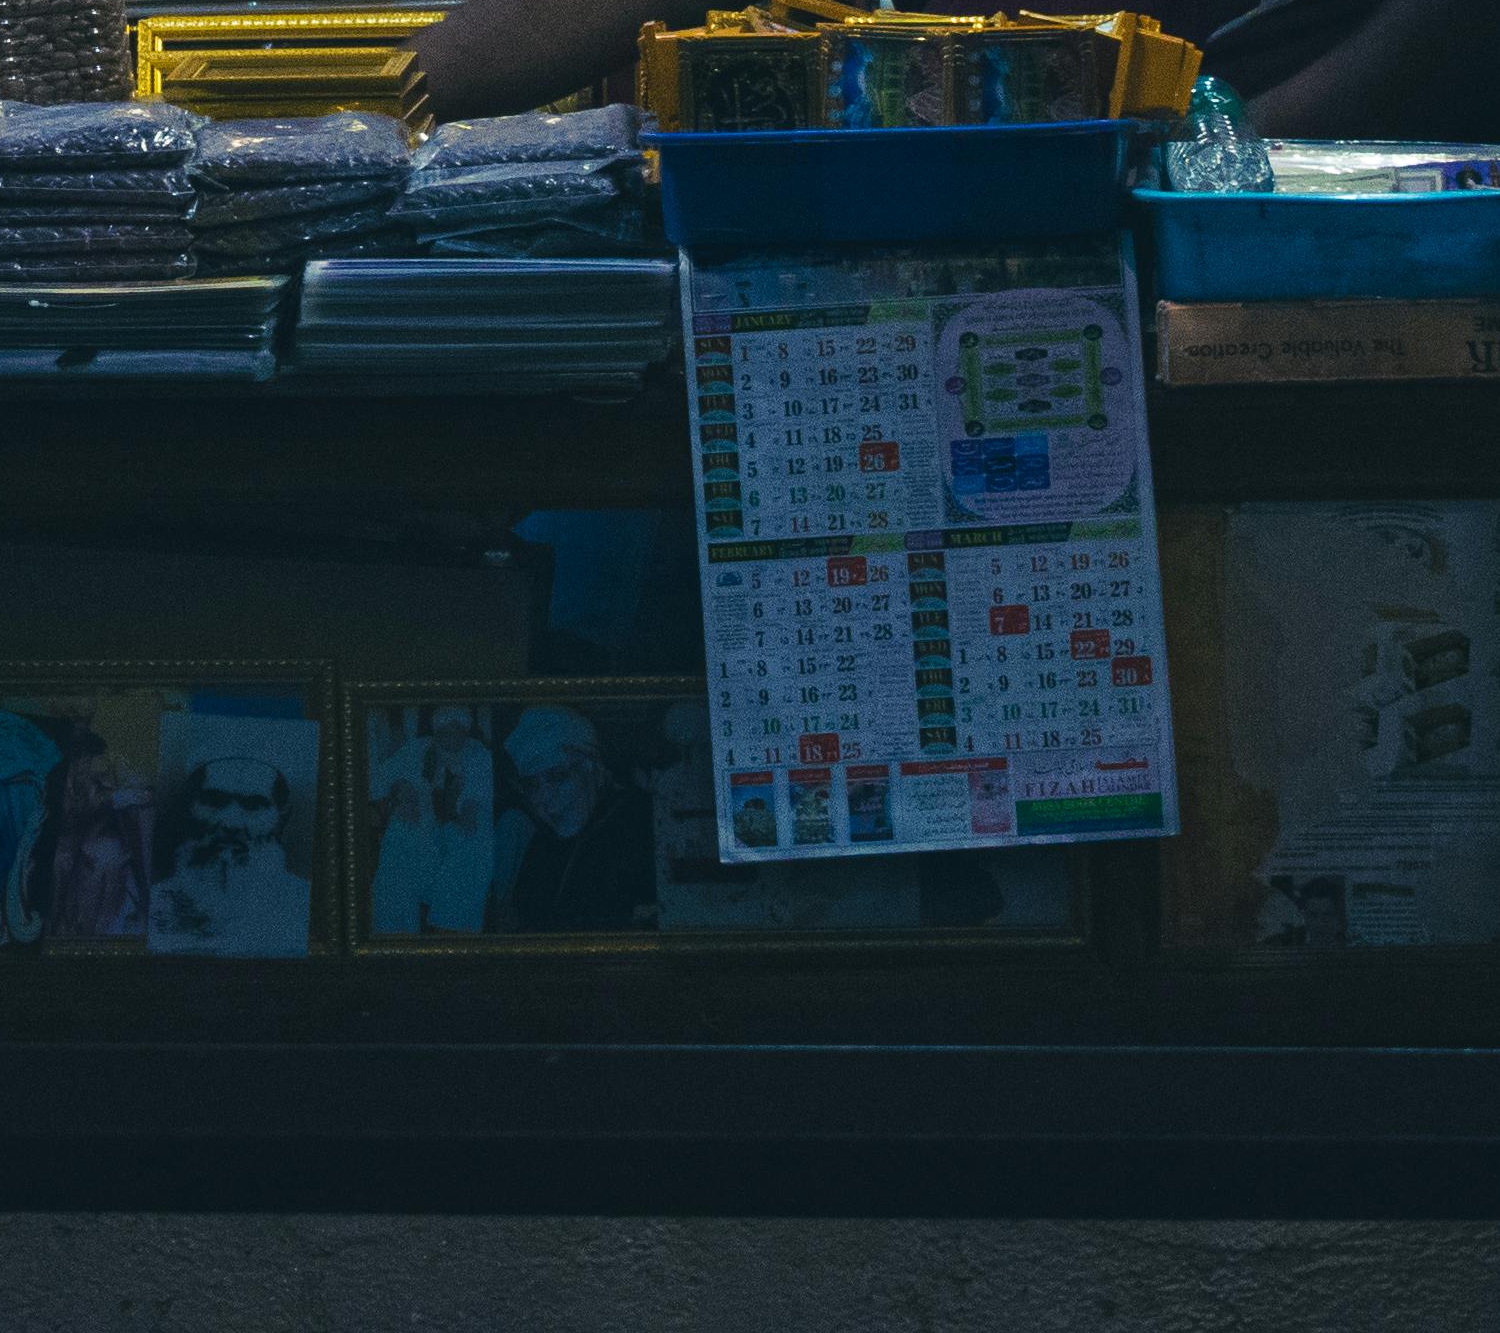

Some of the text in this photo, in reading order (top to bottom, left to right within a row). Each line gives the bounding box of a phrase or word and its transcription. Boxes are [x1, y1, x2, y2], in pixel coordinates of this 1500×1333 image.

[734, 316, 793, 329] JANUARY
[817, 341, 835, 357] 15
[856, 338, 876, 354] 22
[895, 336, 916, 352] 29
[1281, 339, 1366, 358] Valuable
[1378, 338, 1406, 356] The
[819, 369, 837, 385] 16
[858, 367, 878, 383] 23
[897, 365, 918, 381] 30
[784, 400, 803, 417] 10
[821, 398, 840, 414] 17
[860, 396, 880, 412] 24
[899, 394, 919, 410] 31
[785, 430, 803, 445] 11
[823, 427, 842, 443] 18
[861, 425, 883, 441] 25
[787, 458, 805, 475] 12
[825, 456, 843, 472] 19
[789, 488, 808, 504] 13
[825, 485, 846, 501] 20
[865, 483, 887, 500] 27
[791, 517, 809, 533] 14
[828, 514, 846, 530] 21
[868, 512, 889, 528] 28
[950, 531, 1003, 545] MARCH
[711, 545, 775, 560] FEBRUARY
[1030, 552, 1129, 572] 12 19 26
[792, 566, 889, 587] 12 19 26
[1032, 581, 1130, 601] 13 20 27
[794, 595, 890, 616] 13 20 27
[1034, 610, 1133, 630] 14 21 28
[796, 624, 892, 645] 14 21 28
[1036, 639, 1135, 660] 15 22 29
[798, 655, 856, 674] 15 22
[1038, 669, 1137, 689] 16 23 30
[800, 685, 857, 703] 16 23
[1002, 698, 1138, 720] 10 17 24 31
[763, 714, 859, 734] 10 17 24
[1004, 729, 1102, 749] 11 18 25
[803, 745, 823, 761] 18
[841, 742, 862, 759] 25
[1025, 778, 1095, 798] FIZAH
